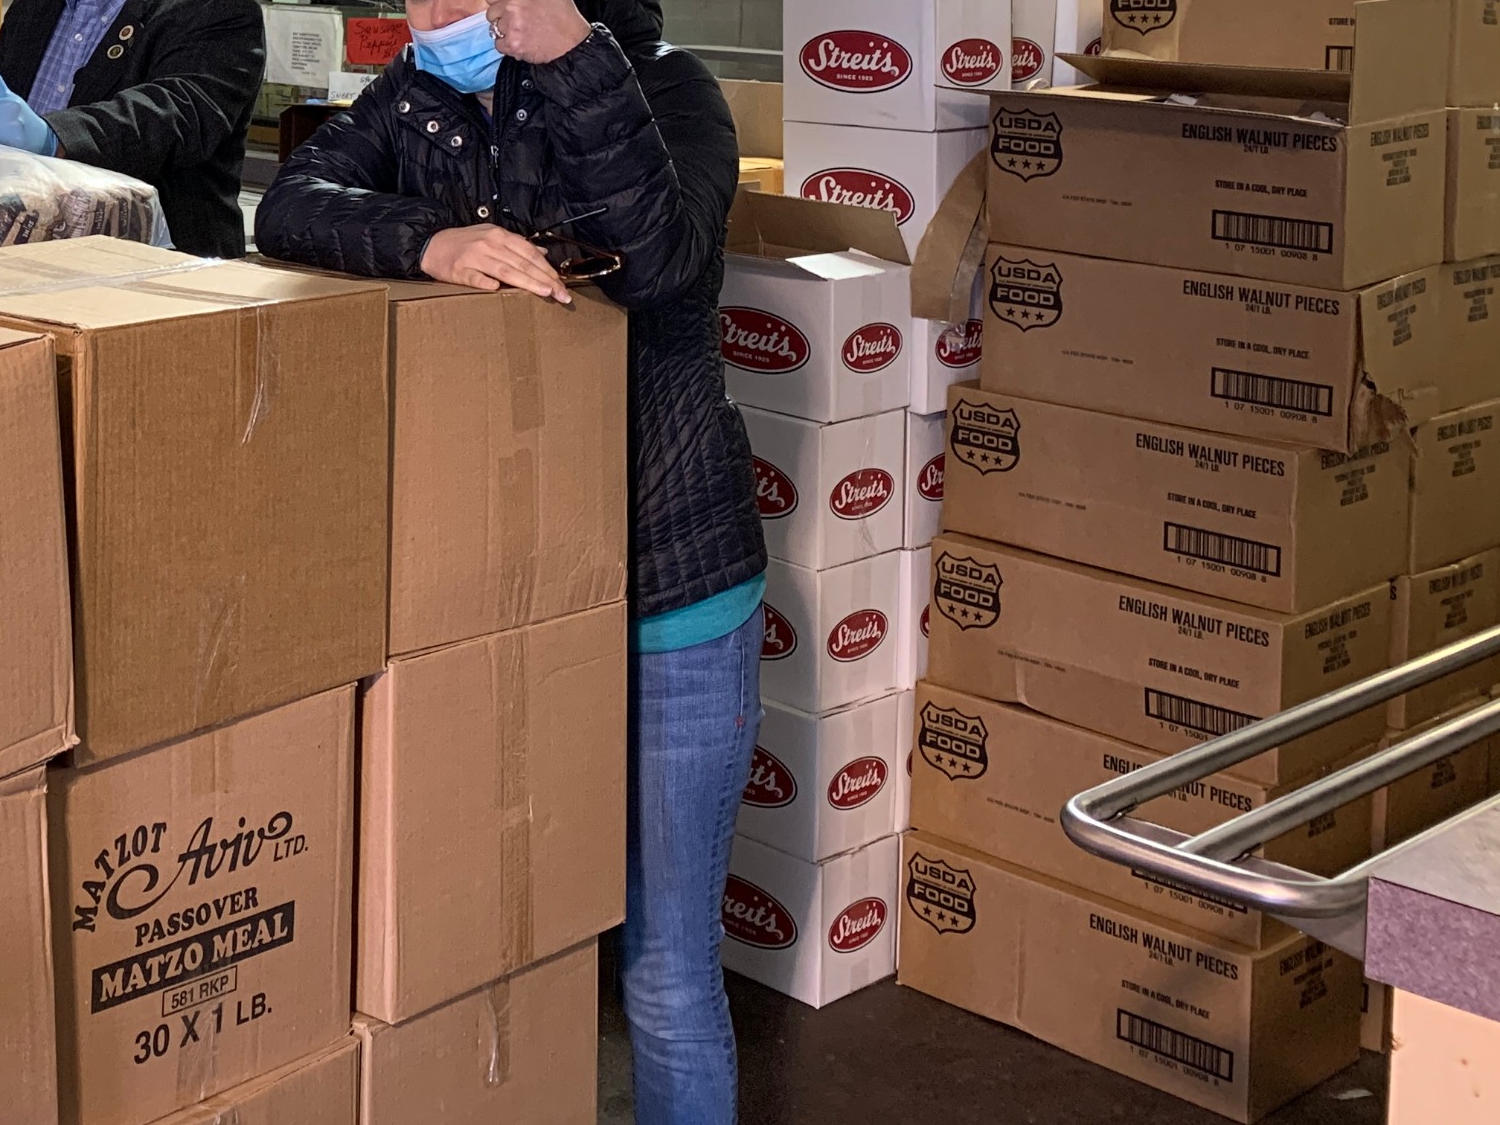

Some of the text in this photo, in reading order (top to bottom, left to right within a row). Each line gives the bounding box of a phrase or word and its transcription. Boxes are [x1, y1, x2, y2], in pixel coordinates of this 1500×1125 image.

[808, 38, 899, 76] Streit's
[945, 45, 996, 73] Streit's
[836, 73, 856, 81] SINCE
[997, 116, 1057, 134] USDA
[1182, 123, 1337, 152] ENGLISH WALNUT PIECES
[998, 138, 1055, 155] FOOD
[808, 175, 901, 218] Streit's
[1215, 179, 1235, 190] STORE
[1236, 181, 1244, 191] IN
[1271, 185, 1285, 196] DRY
[1287, 187, 1308, 197] PLACE
[1234, 244, 1245, 253] 07
[998, 267, 1057, 284] USDA
[996, 287, 1055, 305] FOOD
[720, 313, 797, 361] Streit's
[846, 327, 897, 361] Streit's
[1118, 595, 1270, 647] ENGLISH WALNUT PIECES
[926, 710, 983, 737] USDA
[925, 732, 980, 758] FOOD
[72, 822, 168, 933] MATZOT
[105, 811, 310, 919] Aviv LTD.
[915, 862, 969, 892] USDA
[913, 885, 969, 912] FOOD
[134, 886, 260, 948] PASSOVER
[833, 899, 884, 940] Streit's
[101, 912, 289, 1002] MATZO MEAL
[1089, 913, 1239, 980] ENGLISH WALNUT PIECES
[170, 976, 230, 1010] 581 RKP
[133, 993, 272, 1066] 30 X 1 LB.
